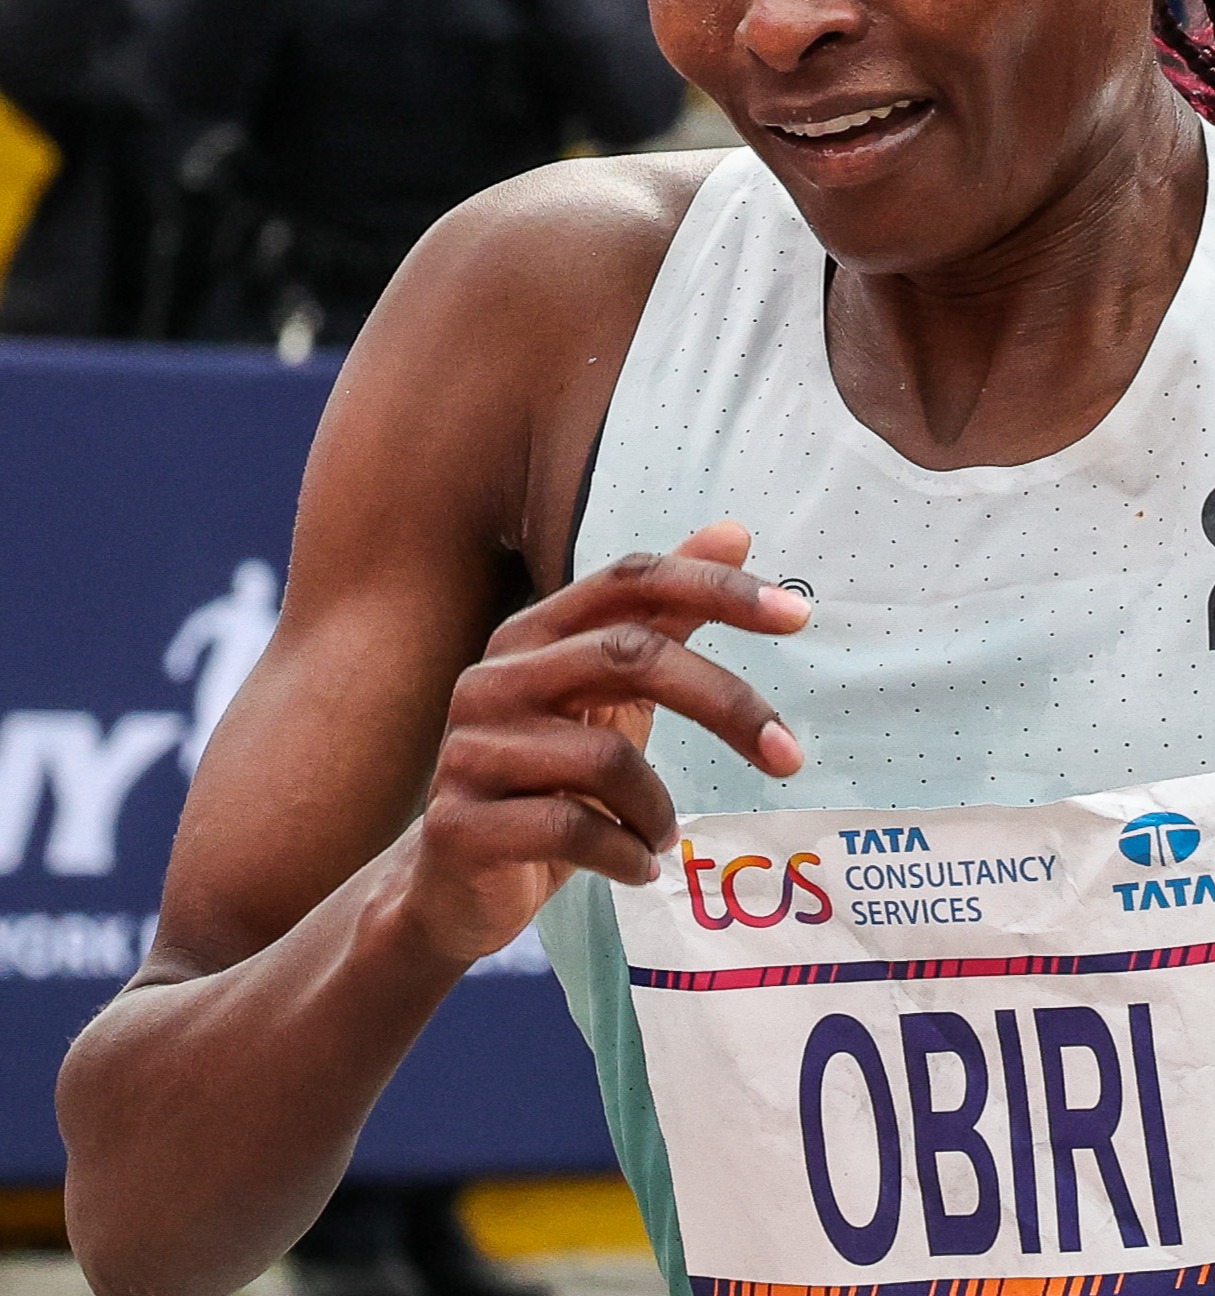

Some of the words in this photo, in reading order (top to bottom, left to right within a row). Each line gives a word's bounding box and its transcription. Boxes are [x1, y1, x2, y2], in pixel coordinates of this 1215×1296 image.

[838, 827, 930, 855] TATA
[681, 839, 833, 930] tcs
[845, 855, 1056, 891] CONSULTANCY
[851, 896, 982, 926] SERVICES
[800, 1003, 1183, 1266] OBIRI
